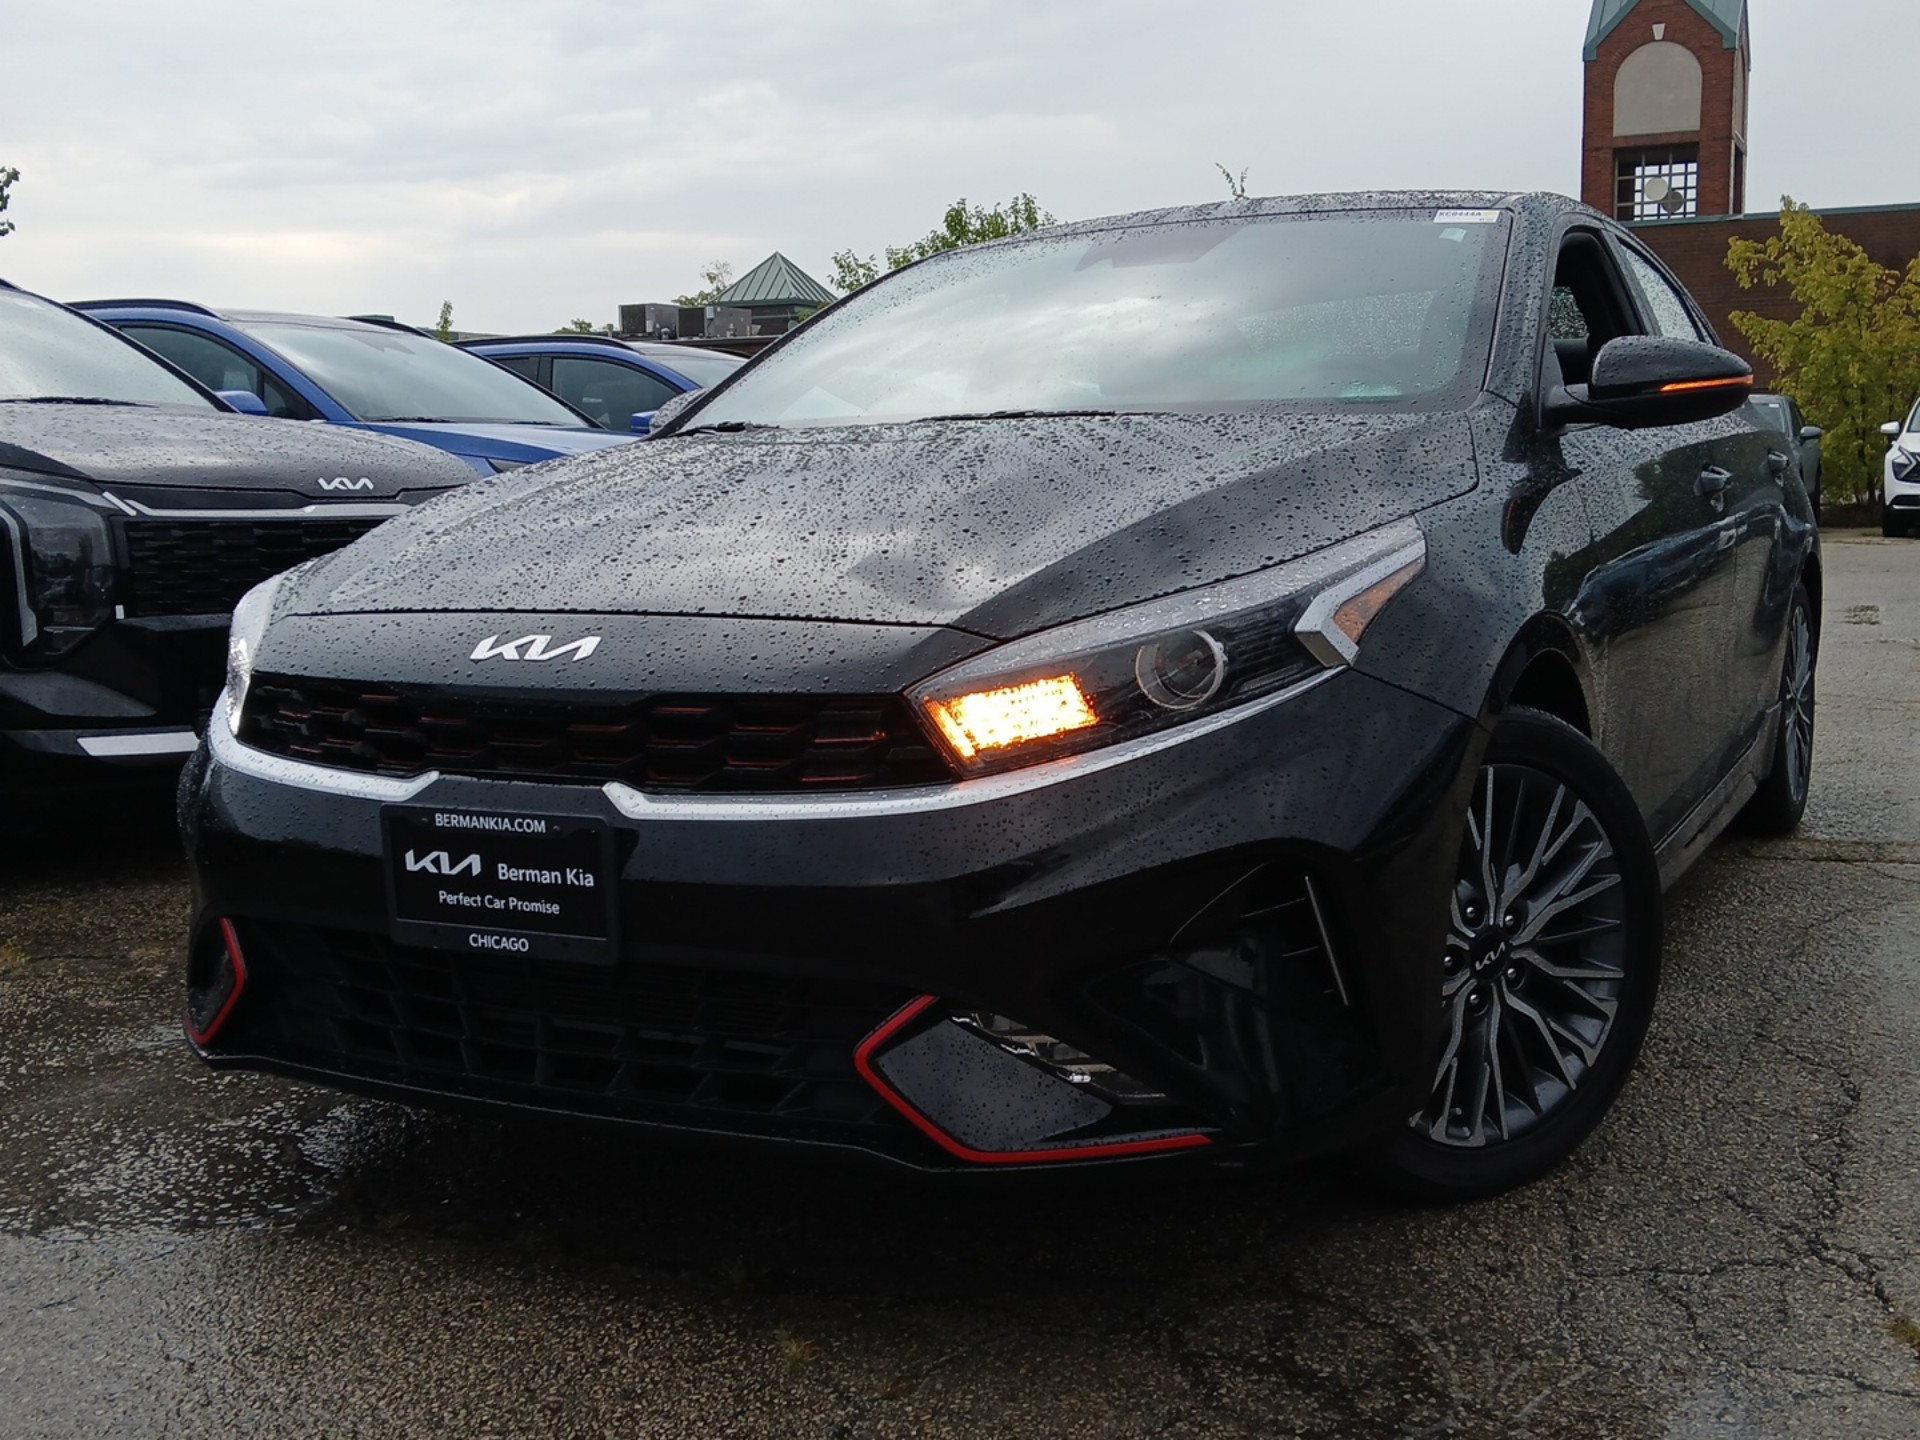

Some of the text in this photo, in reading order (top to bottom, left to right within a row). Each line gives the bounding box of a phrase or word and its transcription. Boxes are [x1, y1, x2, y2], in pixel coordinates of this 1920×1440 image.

[318, 477, 374, 490] KIA
[469, 635, 601, 661] KIA
[435, 813, 546, 833] BERMANKIA.COM
[405, 849, 481, 876] KIA
[497, 863, 594, 886] Berman Kia
[439, 890, 560, 914] Perfect Car Promise
[469, 933, 528, 952] CHICAGO
[1475, 941, 1506, 971] KIA
